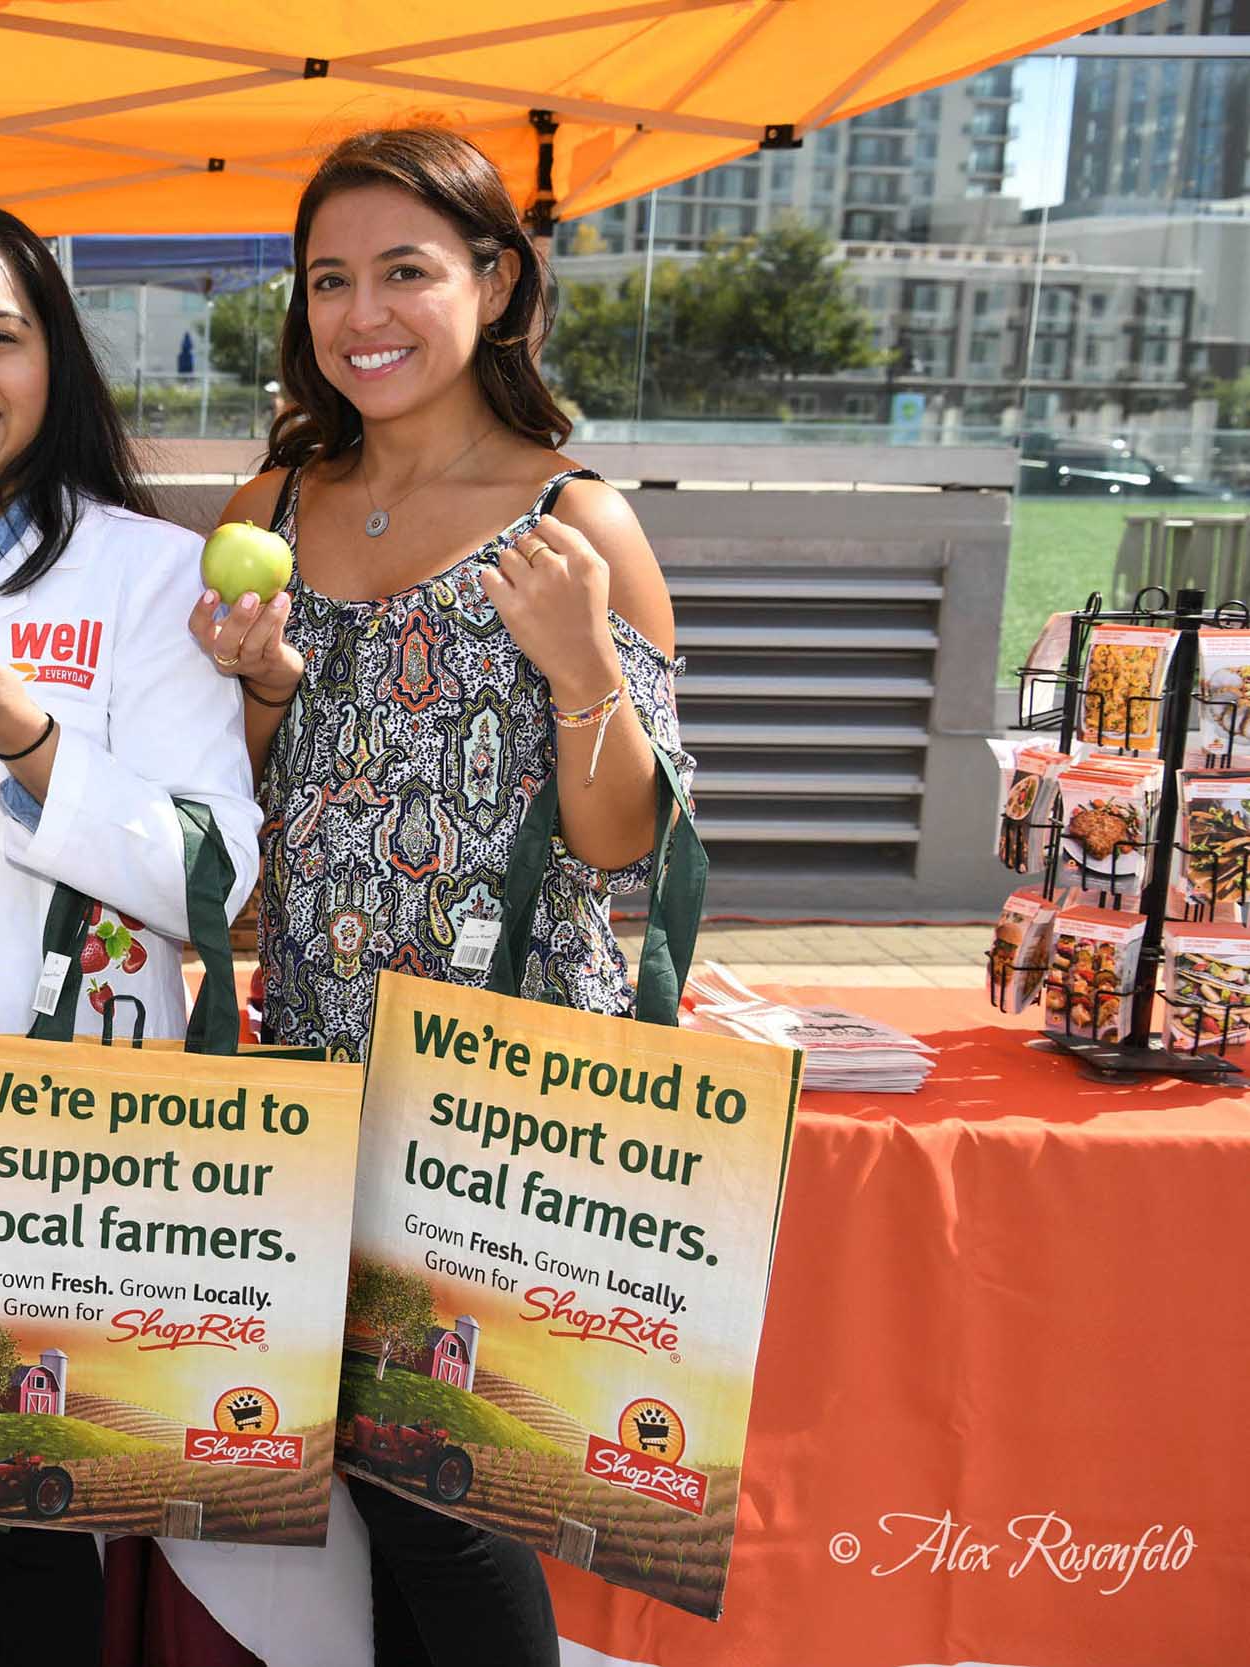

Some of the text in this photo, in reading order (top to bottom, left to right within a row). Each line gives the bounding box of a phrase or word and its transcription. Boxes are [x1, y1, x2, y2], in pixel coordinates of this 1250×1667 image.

[11, 619, 103, 669] well
[45, 669, 89, 684] EVERYDAY
[413, 1010, 747, 1125] We're proud to
[110, 1087, 247, 1133] proud
[261, 1094, 310, 1135] to
[430, 1092, 702, 1187] support our
[192, 1160, 273, 1196] our
[404, 1140, 719, 1267] local farmers.
[100, 1205, 297, 1263] farmers.
[405, 1214, 688, 1312] Grown Fresh. Grown Locally.
[424, 1250, 486, 1286] Grown
[491, 1268, 518, 1293] for
[3, 1297, 68, 1320] Grown
[76, 1302, 104, 1321] for
[51, 1272, 114, 1296] Fresh.
[119, 1279, 187, 1300] Grown
[193, 1283, 272, 1308] Locally.
